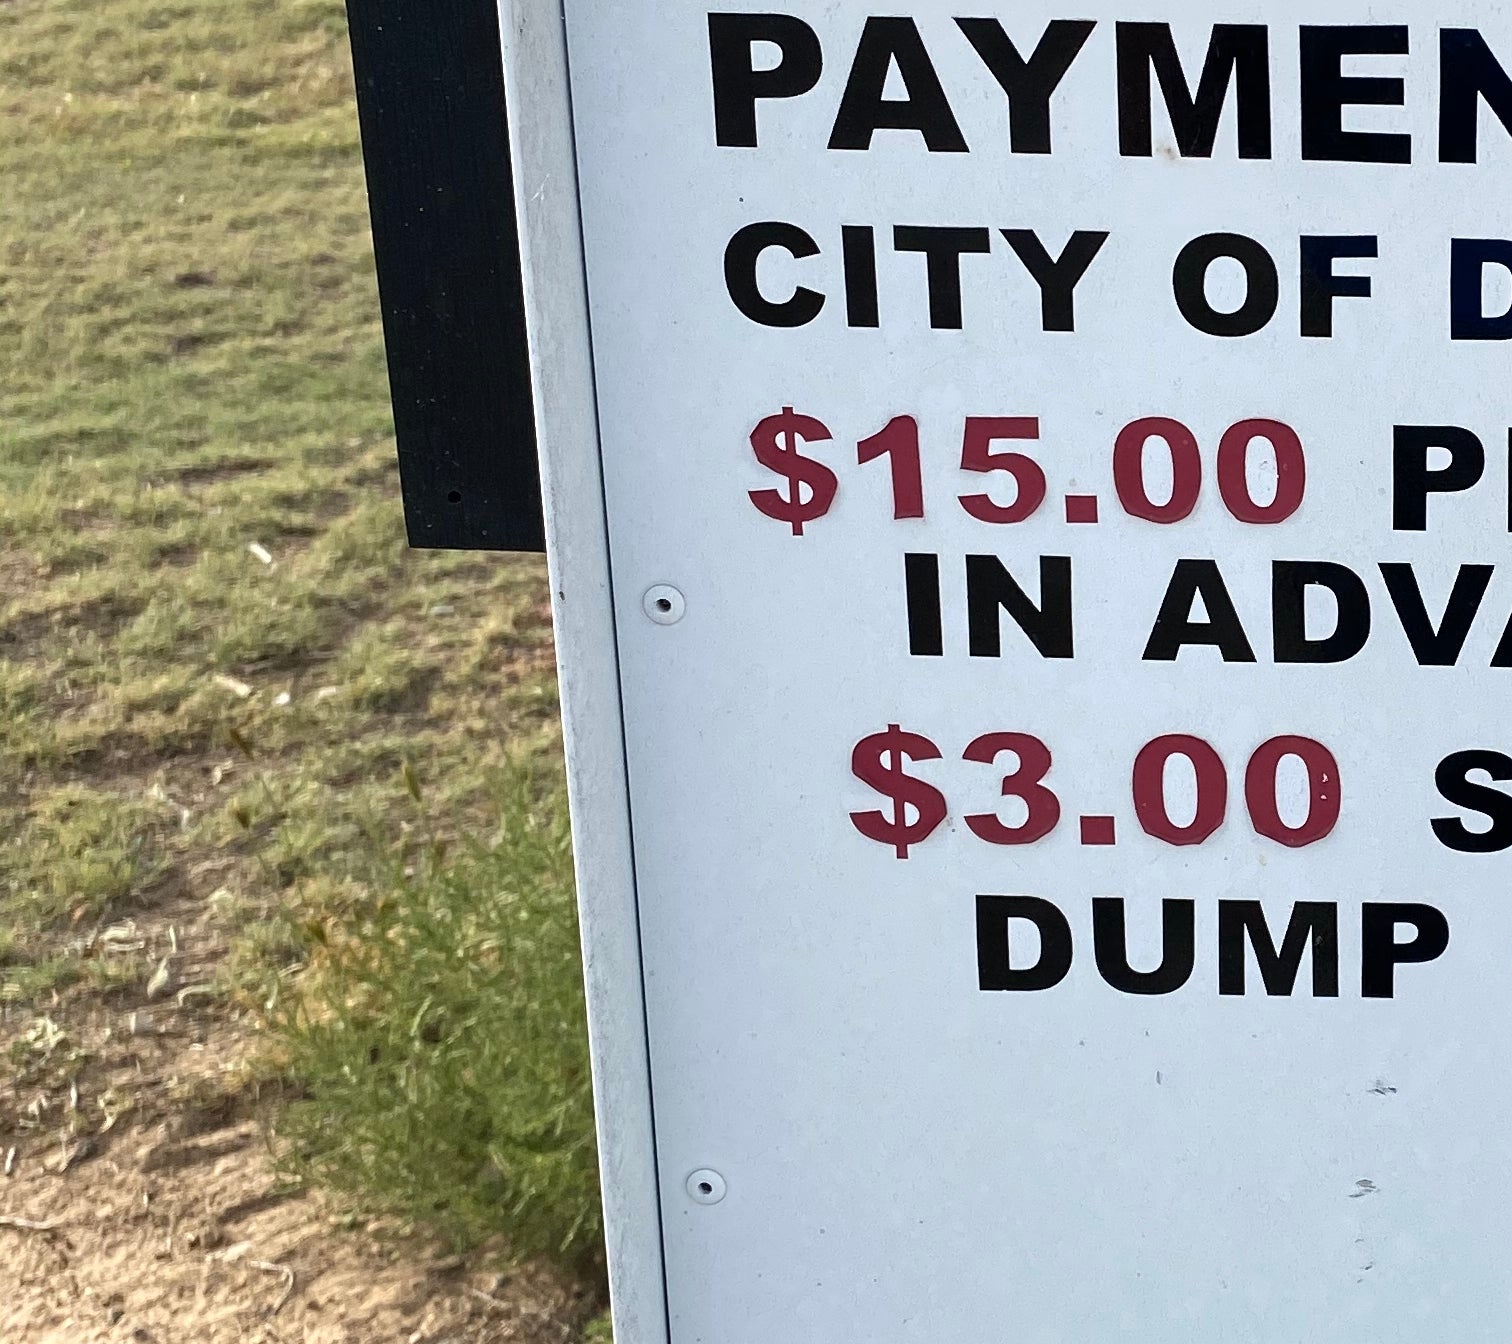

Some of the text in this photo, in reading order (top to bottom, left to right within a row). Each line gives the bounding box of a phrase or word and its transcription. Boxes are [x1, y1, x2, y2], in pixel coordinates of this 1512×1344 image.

[724, 222, 1110, 332] CITY
[1173, 233, 1378, 337] OF
[748, 407, 1305, 536] $15.00
[905, 553, 1073, 658] IN
[849, 724, 1341, 859] $3.00
[976, 895, 1449, 998] DUMP
